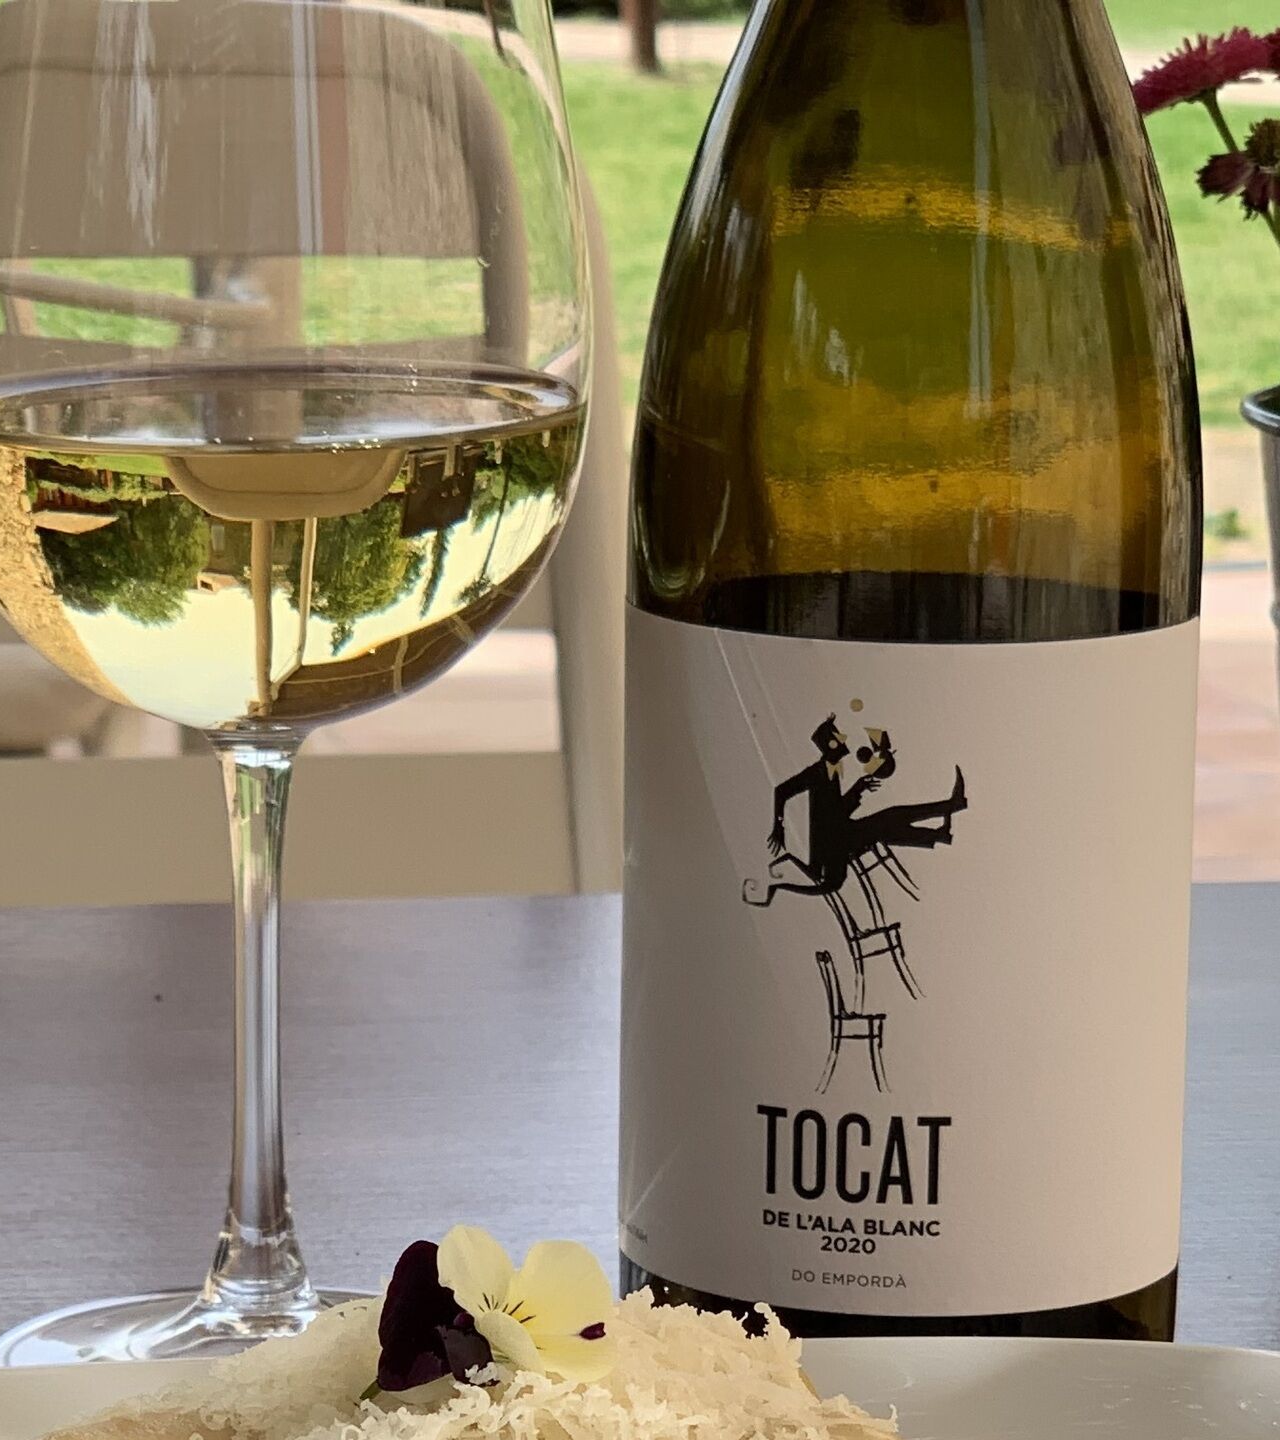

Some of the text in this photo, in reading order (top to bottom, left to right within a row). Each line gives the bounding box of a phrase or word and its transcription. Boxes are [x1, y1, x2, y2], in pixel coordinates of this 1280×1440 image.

[757, 1104, 951, 1205] TOCAT
[762, 1209, 941, 1236] DE L'ALA BLANC
[820, 1236, 876, 1254] 2020
[791, 1269, 907, 1288] DO EMPORDÀ
